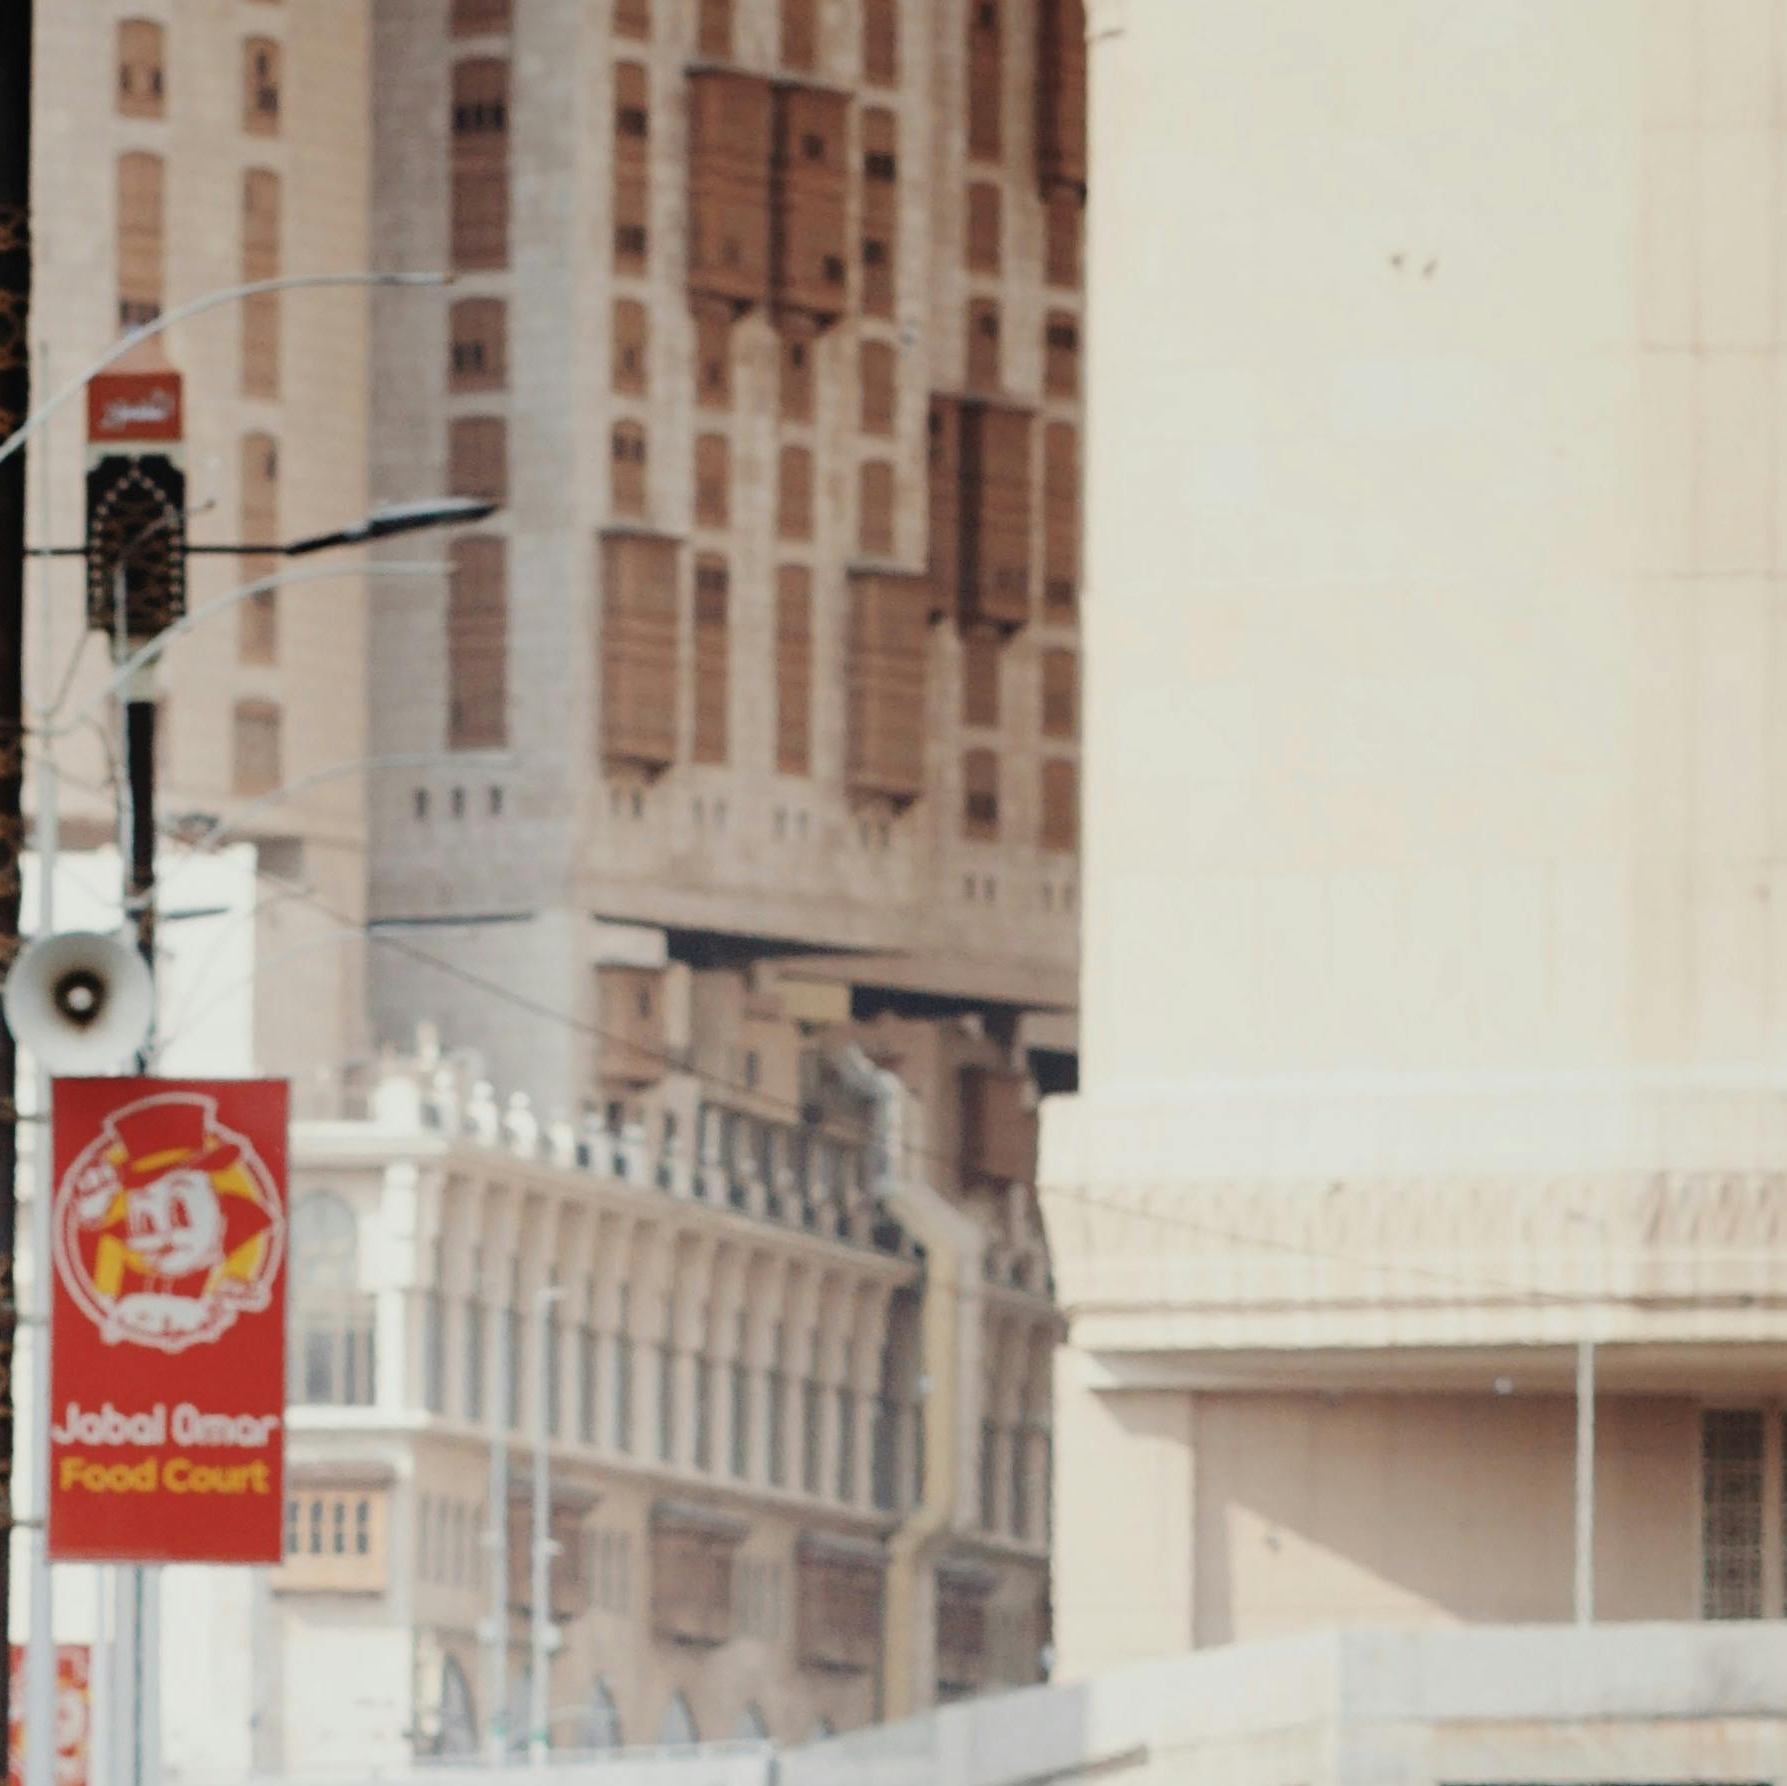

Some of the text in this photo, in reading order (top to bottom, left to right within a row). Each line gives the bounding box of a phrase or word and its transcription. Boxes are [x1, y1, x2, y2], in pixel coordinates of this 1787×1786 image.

[51, 1402, 280, 1448] Jabal Omar
[60, 1456, 270, 1495] Food Court
